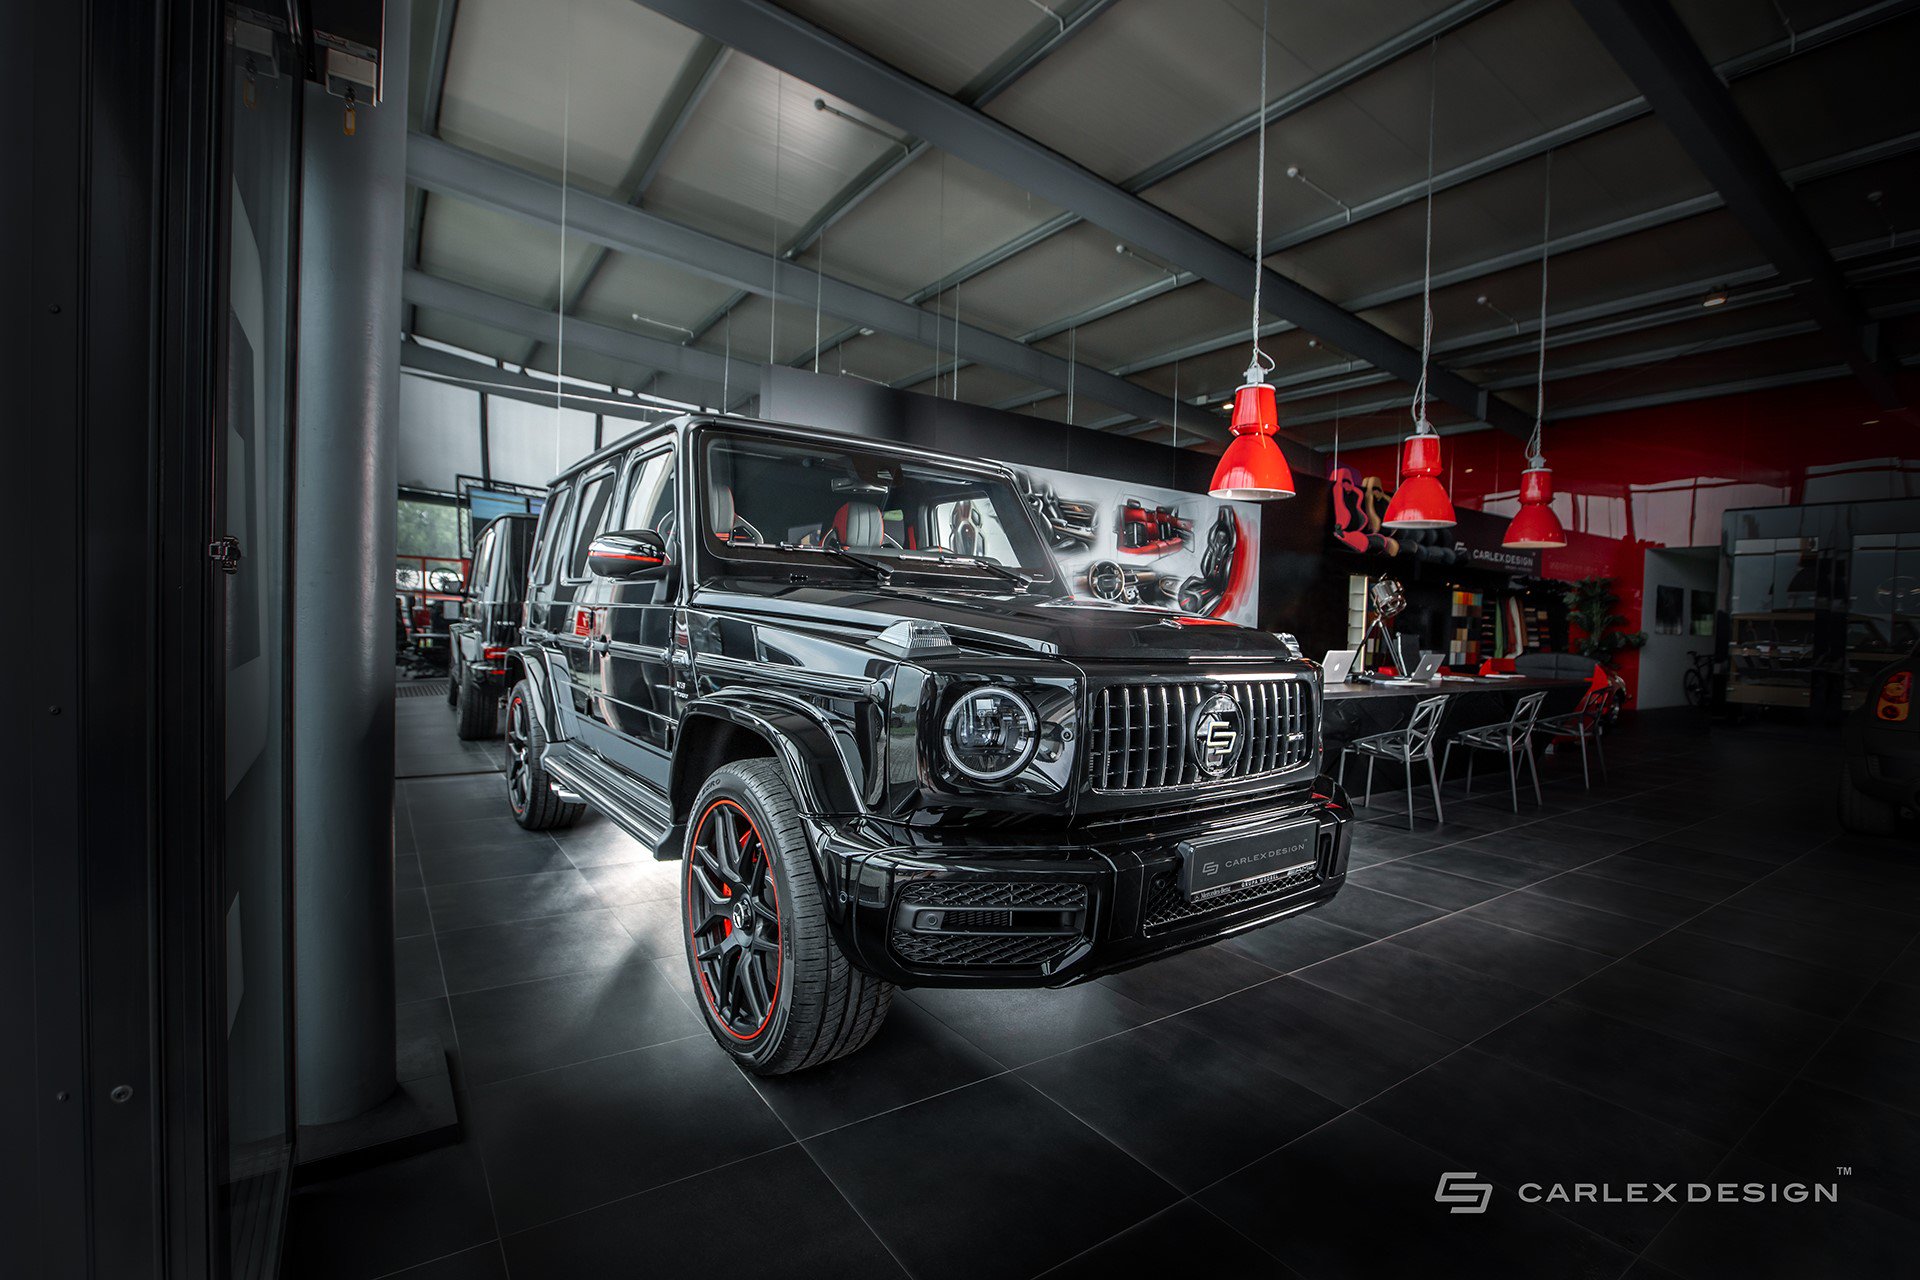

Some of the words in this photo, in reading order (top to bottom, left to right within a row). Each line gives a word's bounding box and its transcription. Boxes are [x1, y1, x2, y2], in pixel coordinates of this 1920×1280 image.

[1473, 549, 1505, 562] CARLEX
[1505, 555, 1533, 566] DESIGN
[1226, 853, 1267, 868] CARLEX
[1268, 844, 1304, 857] DESIGN
